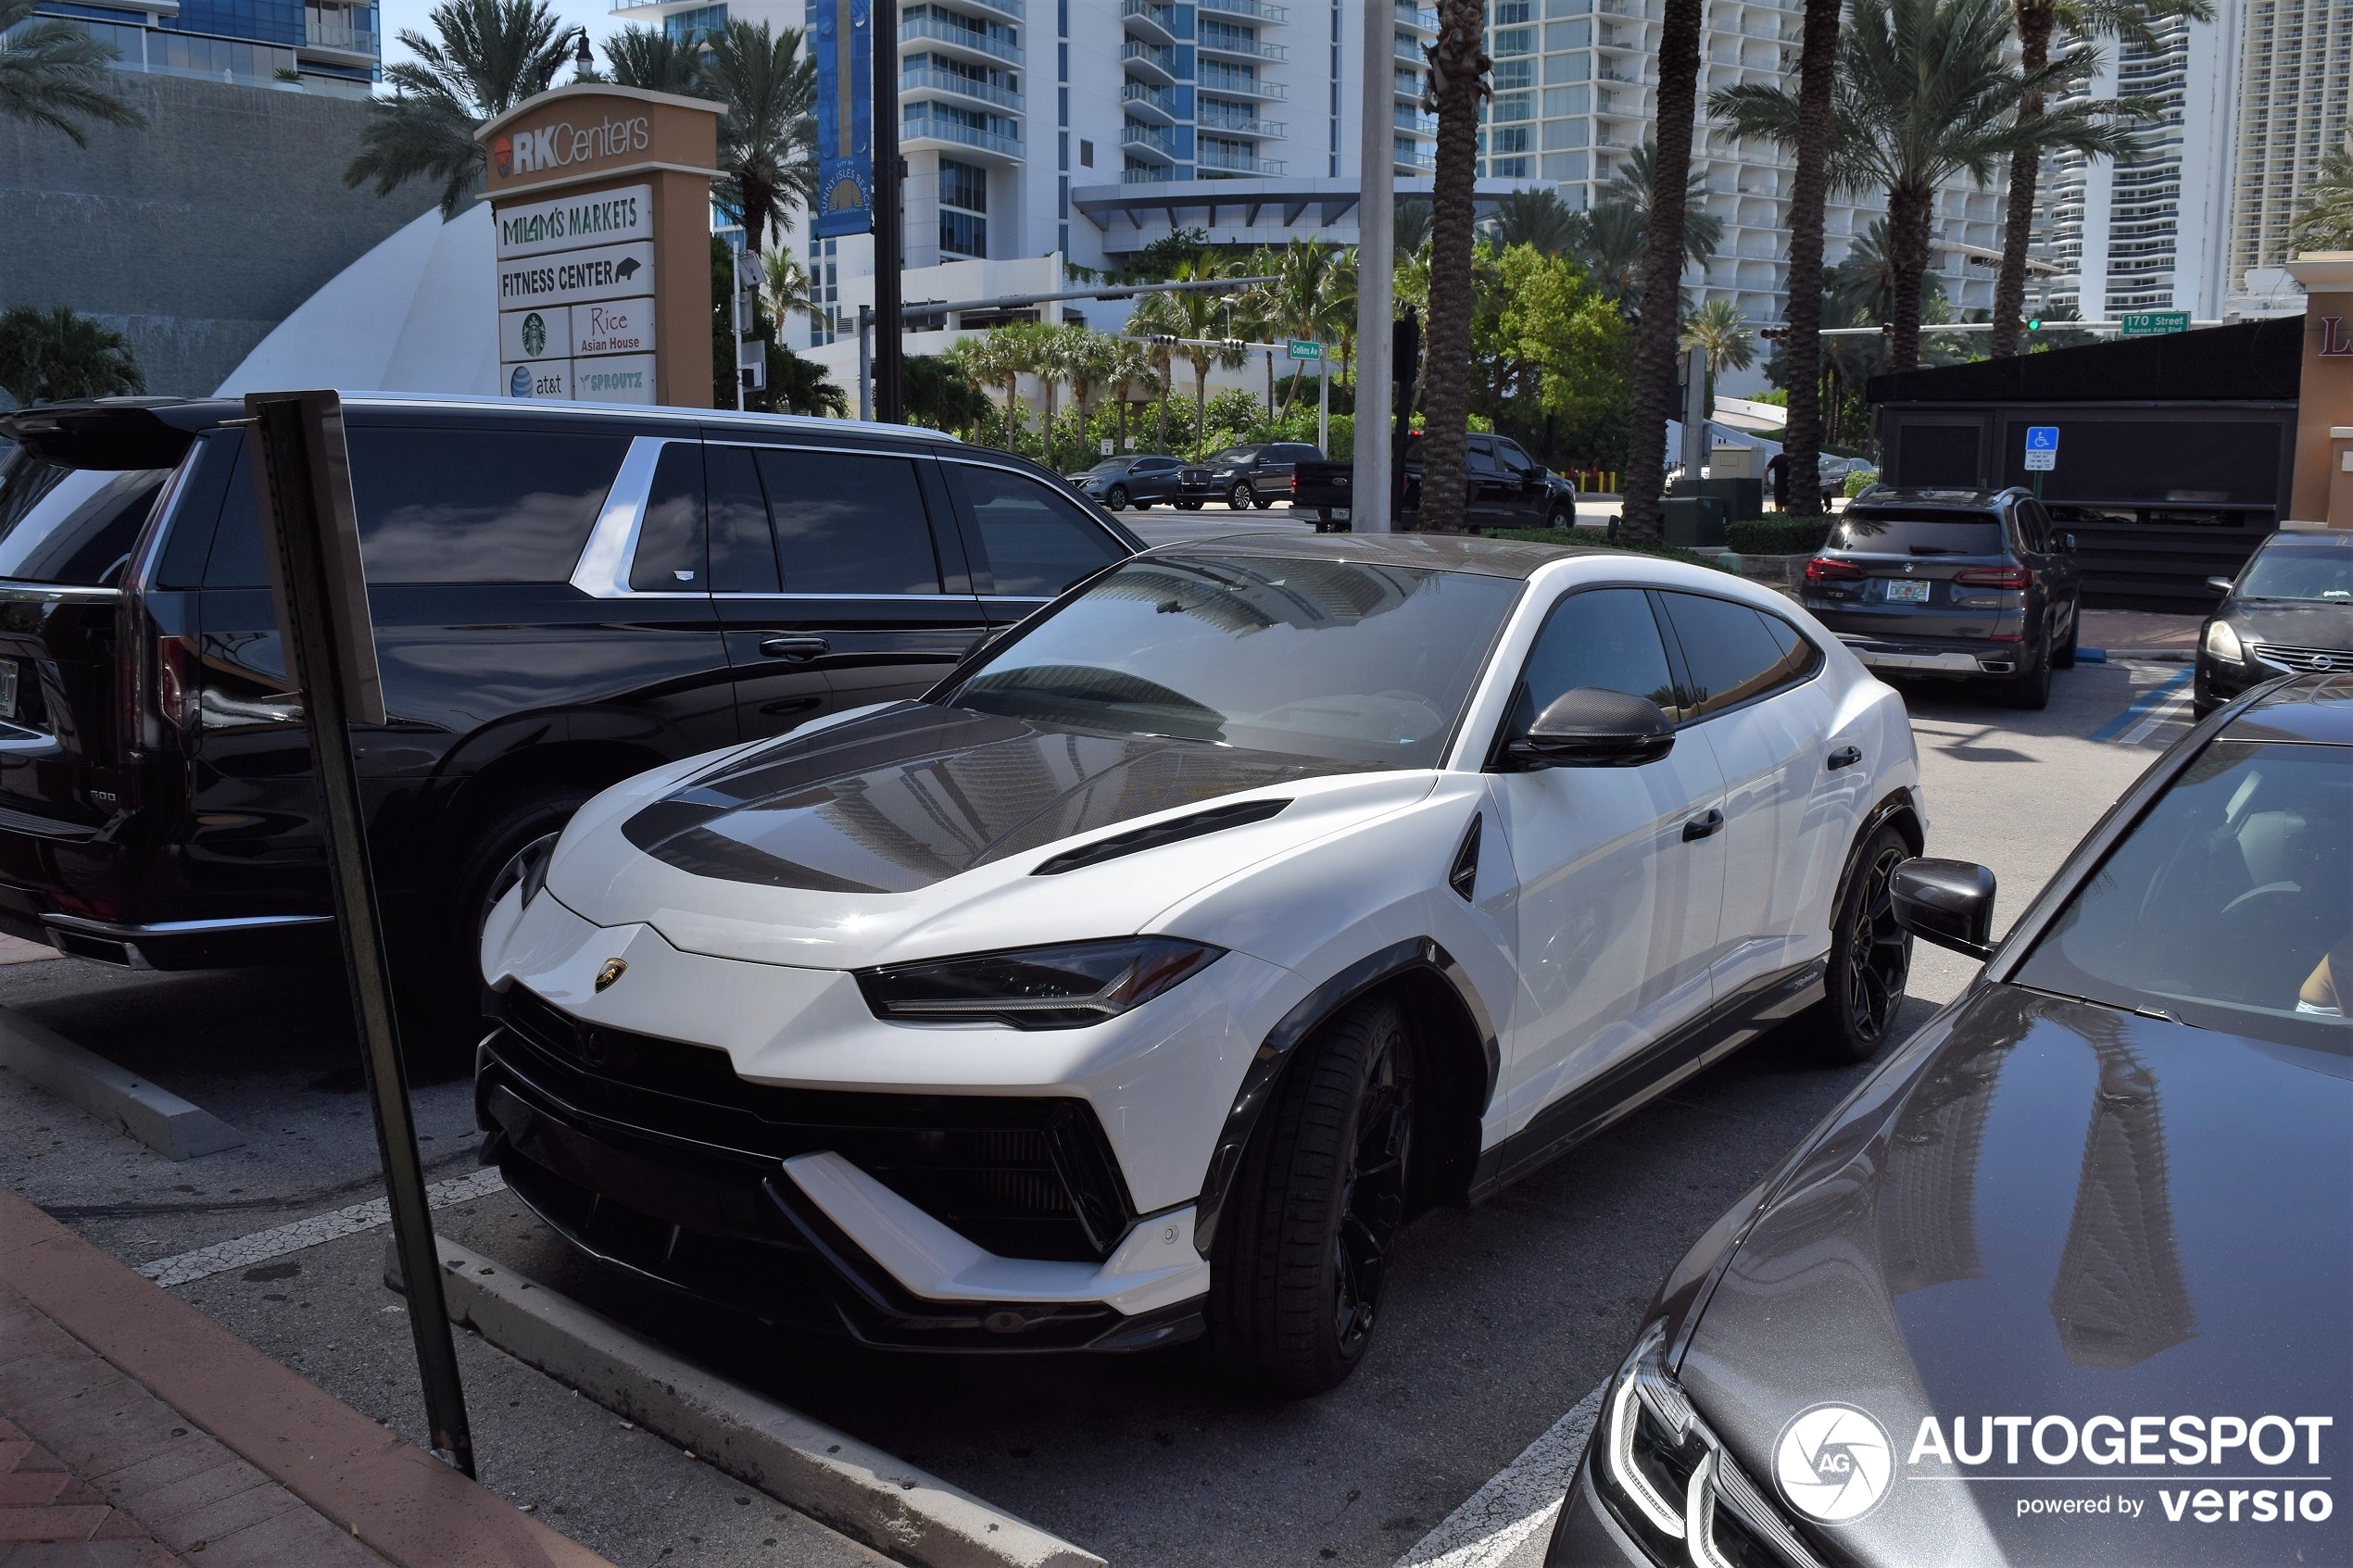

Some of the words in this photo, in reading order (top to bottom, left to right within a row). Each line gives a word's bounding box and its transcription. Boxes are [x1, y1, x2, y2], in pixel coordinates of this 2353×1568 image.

[822, 176, 836, 217] SUNNY
[836, 169, 856, 181] ISLES
[856, 174, 870, 211] BEACH
[503, 207, 564, 245] MILAM'S
[570, 197, 637, 236] MARKETS
[502, 268, 554, 297] FITNESS
[559, 260, 613, 291] CENTER
[592, 307, 628, 336] Rice
[2128, 315, 2149, 326] 170
[2155, 317, 2183, 325] Street
[582, 339, 608, 352] Asian
[610, 337, 639, 350] House
[1292, 345, 1310, 355] Collins
[536, 374, 562, 395] at&t
[590, 372, 642, 392] SPROUTZ
